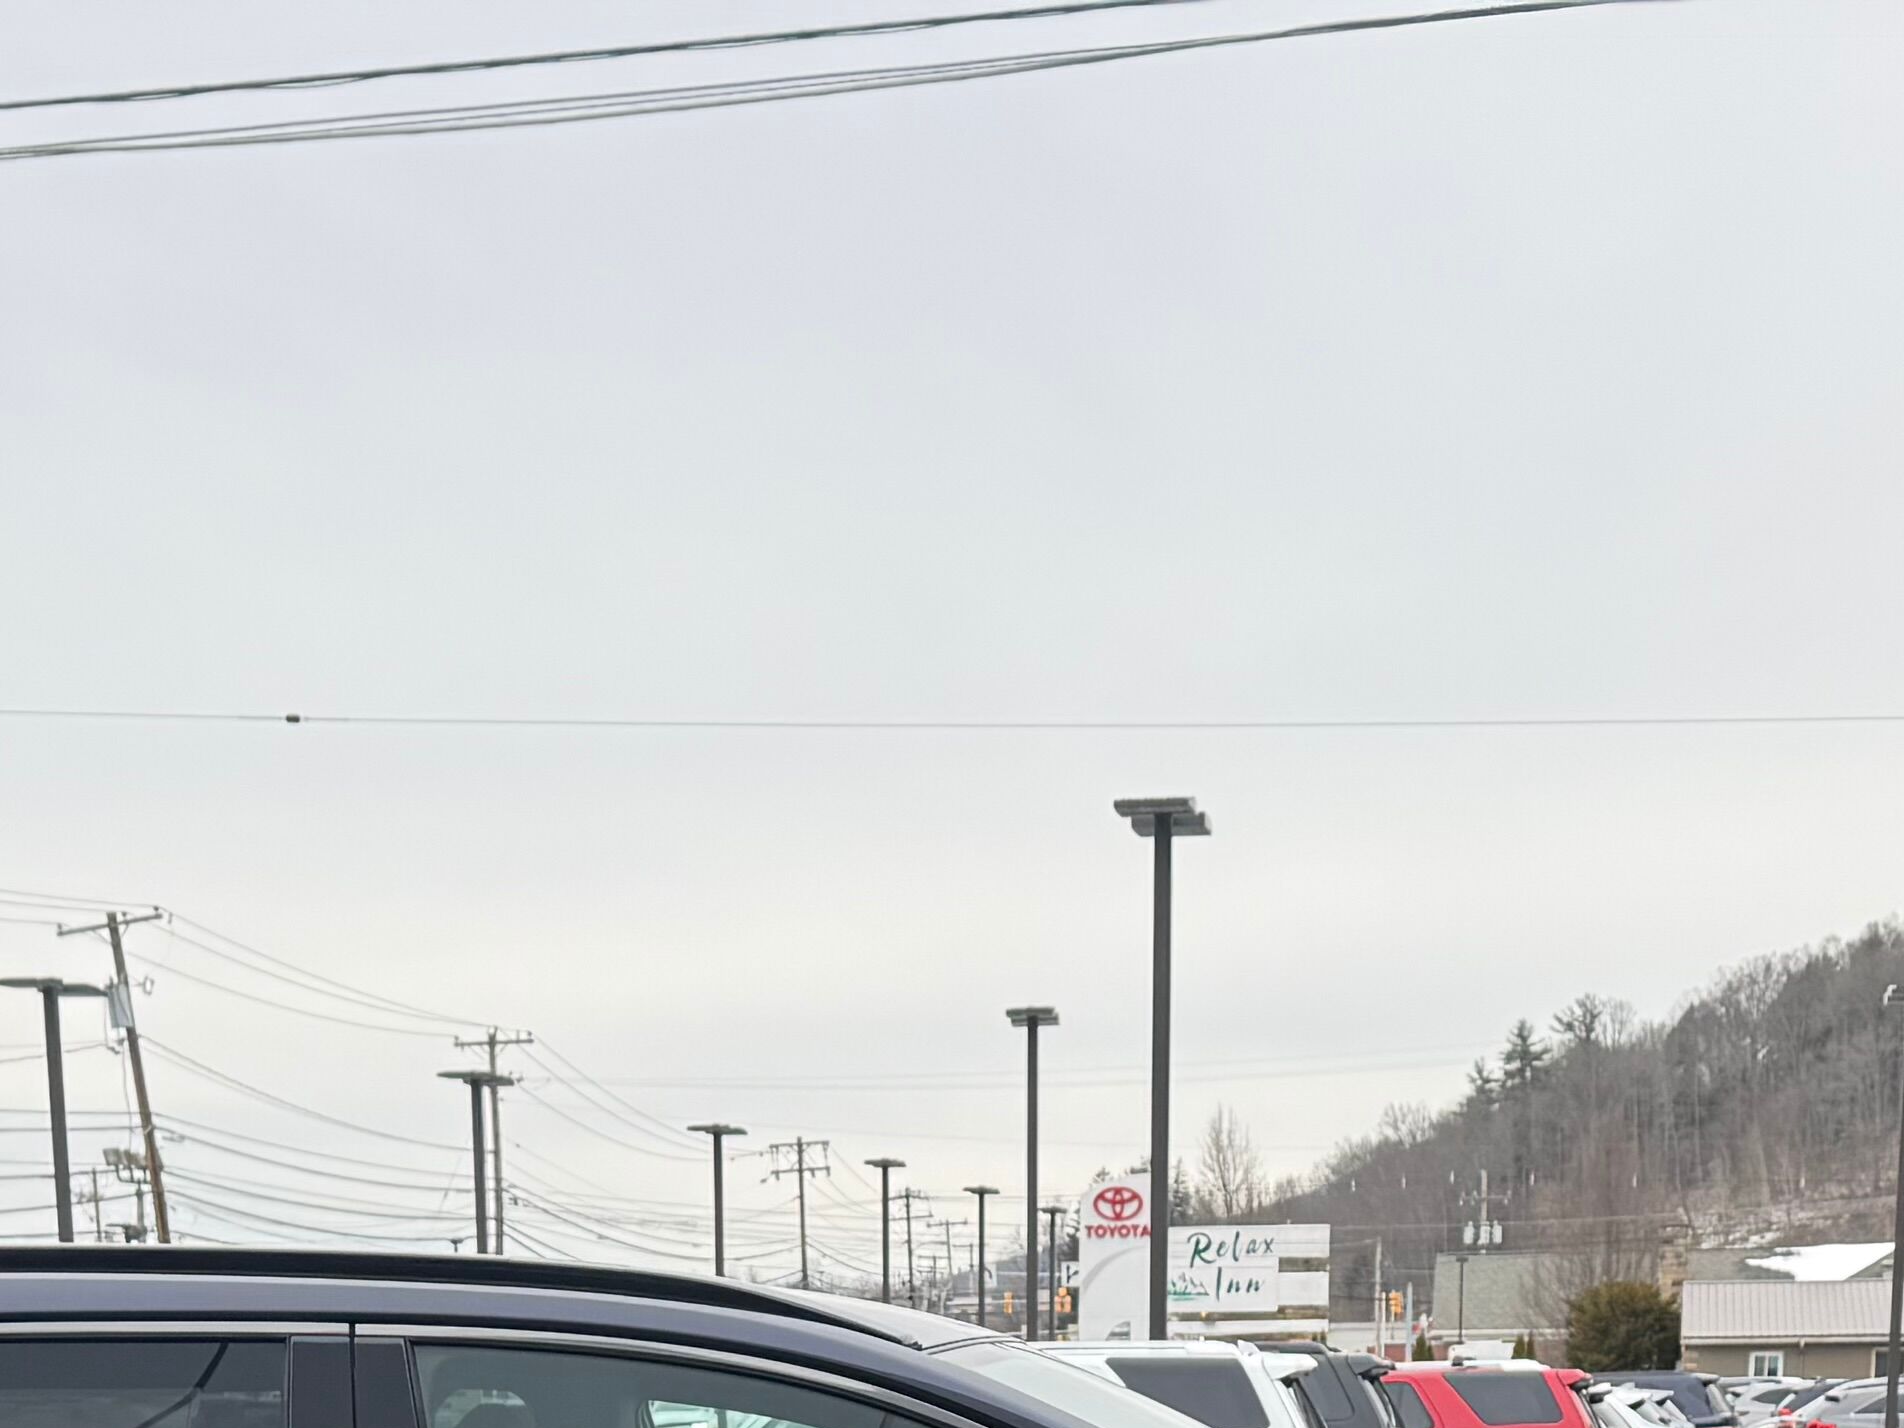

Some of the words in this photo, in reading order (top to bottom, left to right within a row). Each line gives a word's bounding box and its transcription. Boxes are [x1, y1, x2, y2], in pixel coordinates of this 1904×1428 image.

[1085, 1224, 1152, 1240] TOYOTA
[1187, 1231, 1275, 1268] Relax
[1215, 1266, 1263, 1301] Inn
